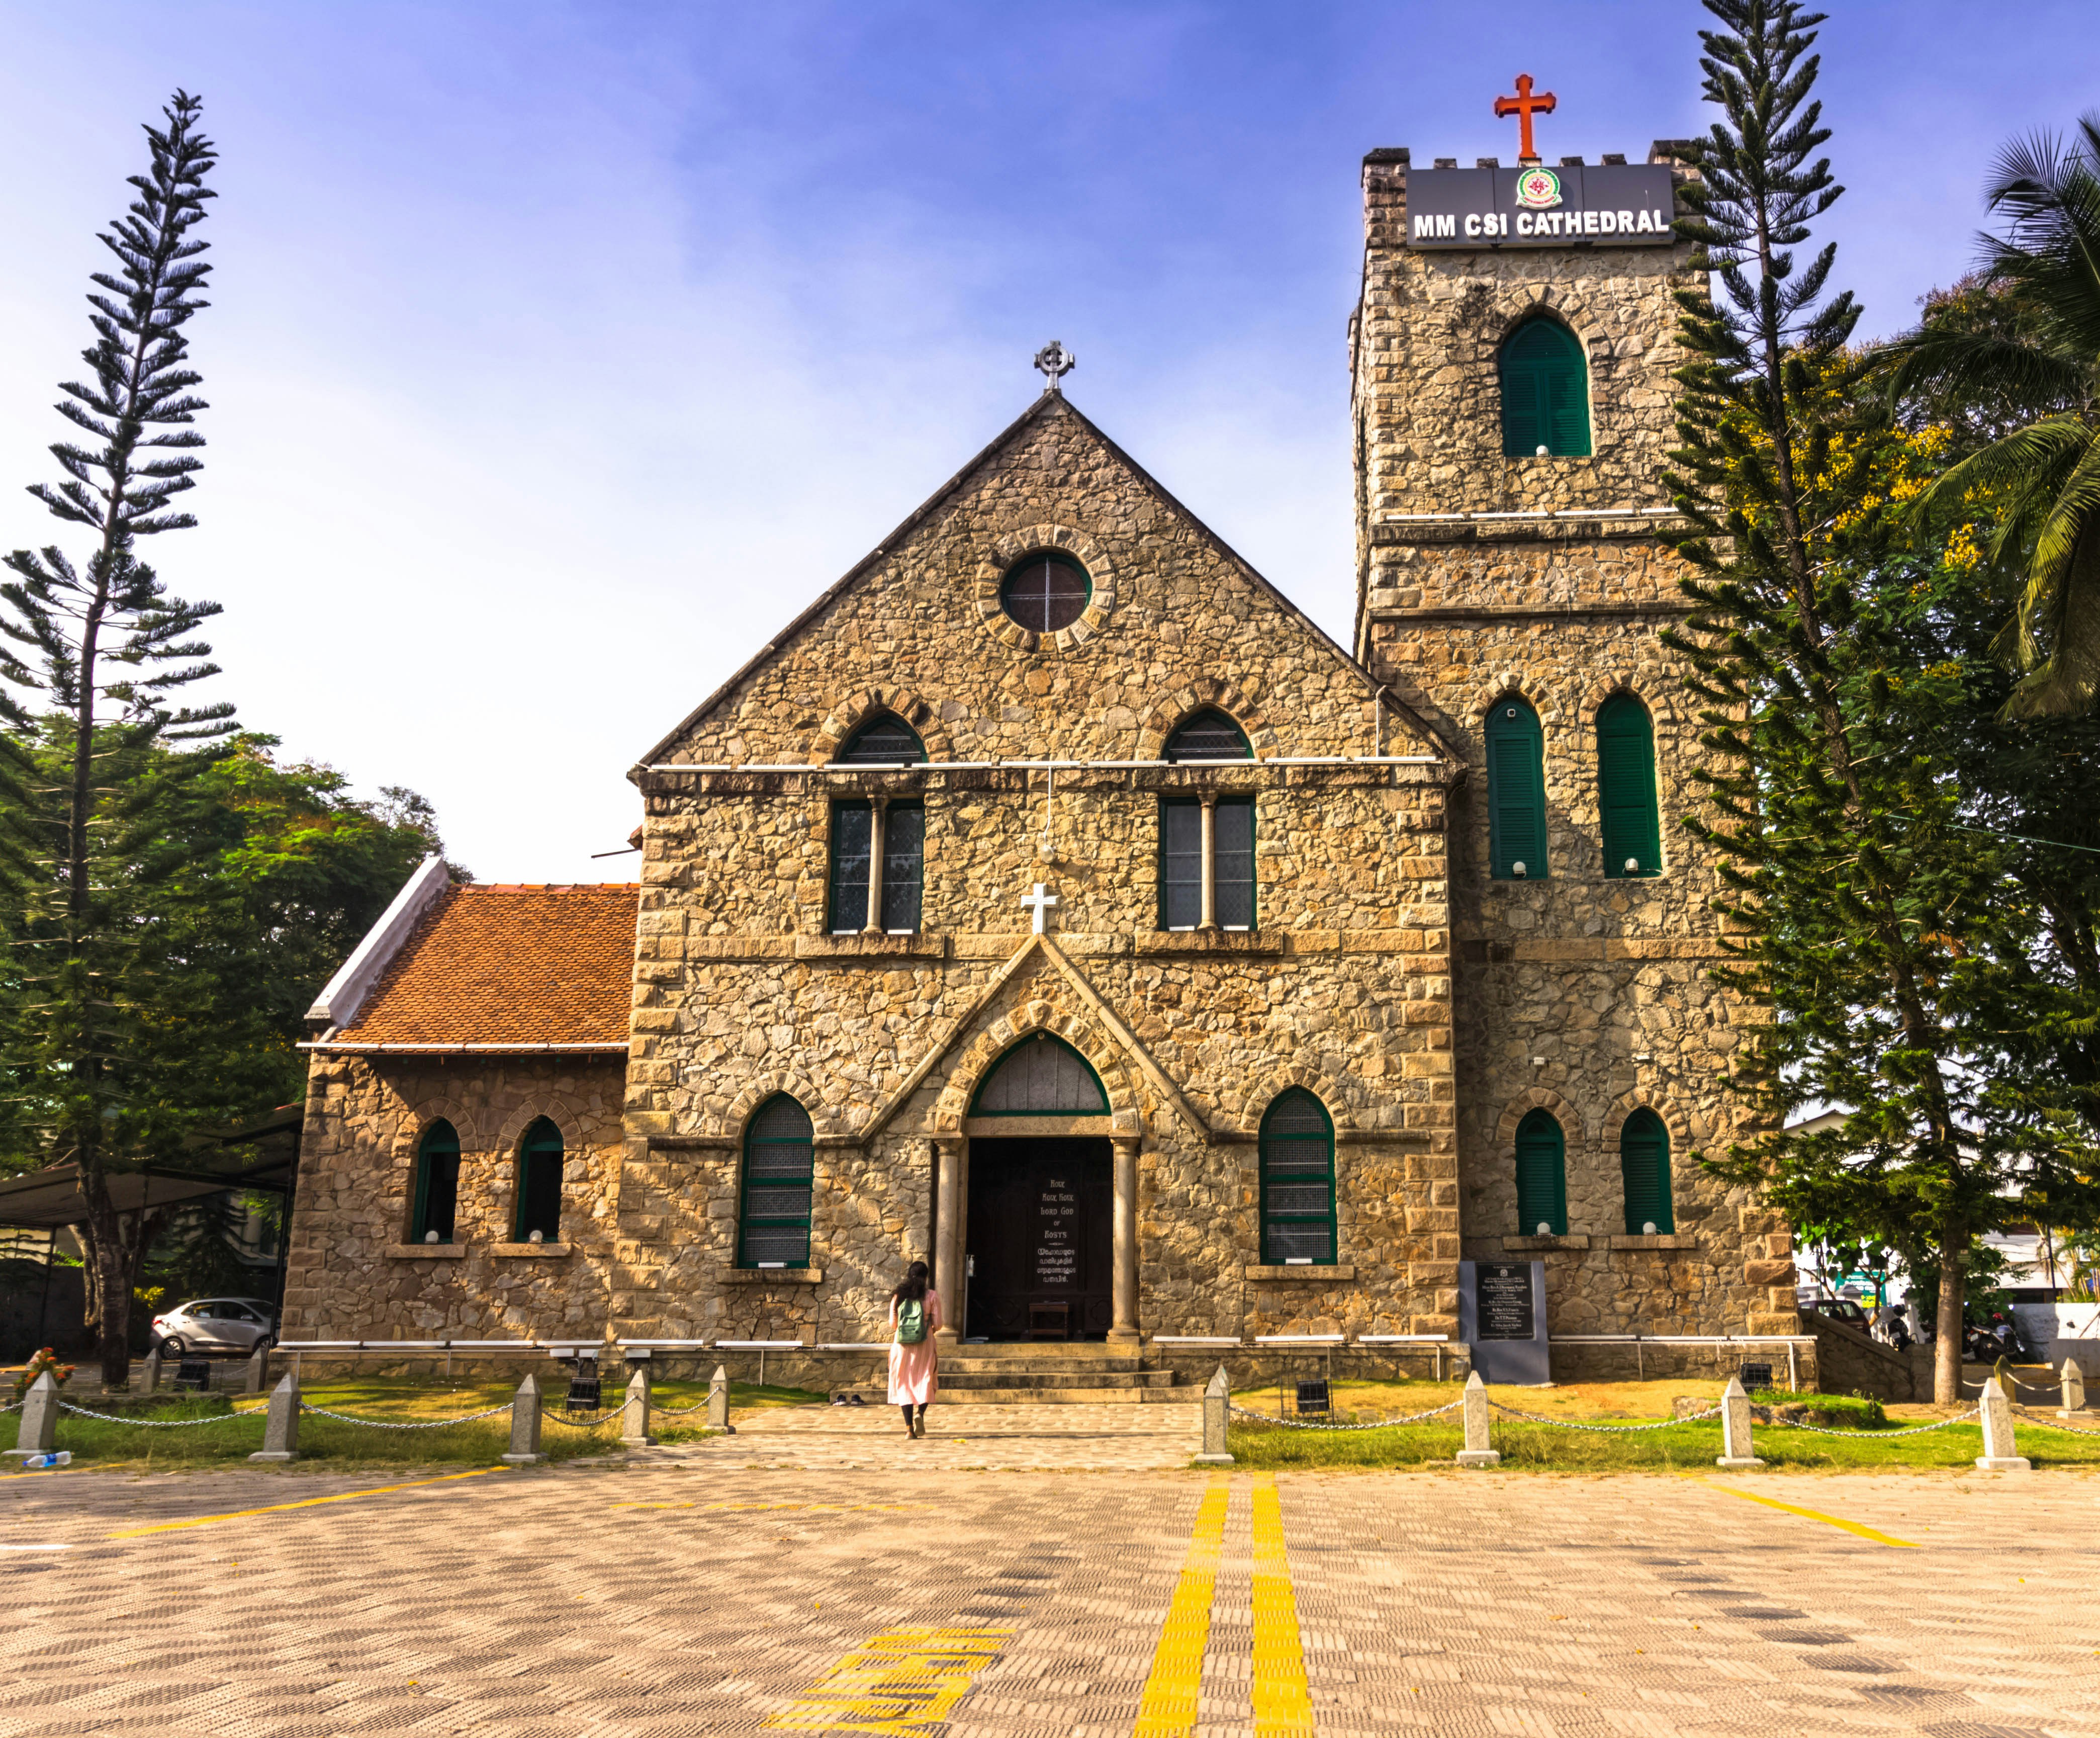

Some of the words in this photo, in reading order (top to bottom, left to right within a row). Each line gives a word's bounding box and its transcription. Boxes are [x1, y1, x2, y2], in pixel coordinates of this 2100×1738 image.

[1414, 214, 1455, 239] MM
[1465, 213, 1508, 236] CSI
[1516, 209, 1670, 235] CATHEDRAL
[1041, 1207, 1058, 1215] LORD
[1061, 1206, 1074, 1215] GOD
[1044, 1230, 1067, 1238] HOSTS
